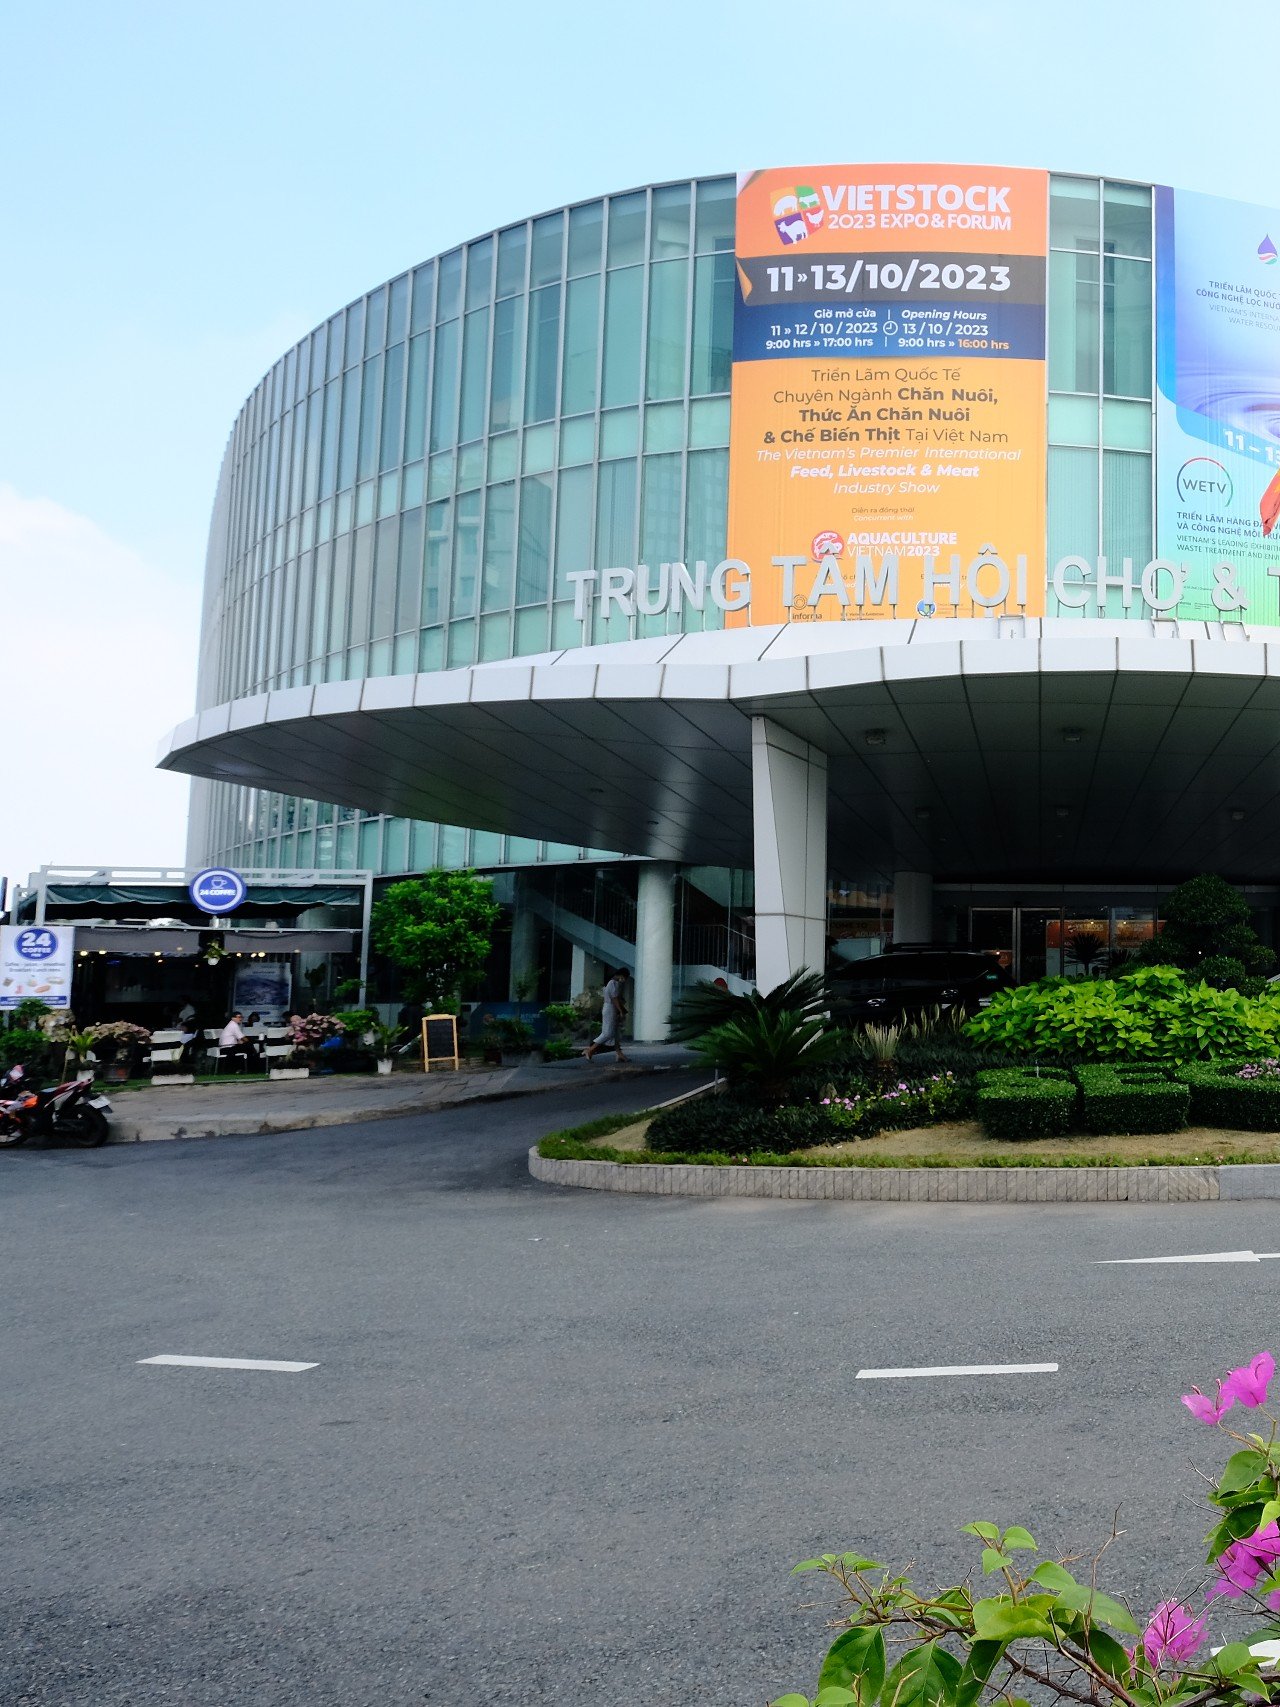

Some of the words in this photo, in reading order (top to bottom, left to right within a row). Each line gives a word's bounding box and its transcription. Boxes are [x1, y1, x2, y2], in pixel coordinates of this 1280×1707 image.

[821, 184, 1011, 213] VIETSTOCK
[828, 214, 876, 229] 2023
[814, 309, 833, 319] Giờ
[835, 308, 853, 318] mở
[856, 308, 877, 318] cửa
[901, 309, 951, 320] Opening
[953, 310, 988, 320] Hours
[771, 325, 781, 336] 11
[766, 340, 790, 349] 9:00
[793, 339, 811, 348] hrs
[823, 338, 852, 347] 17:00
[854, 338, 873, 347] hrs
[898, 338, 924, 348] 9:00
[927, 338, 946, 348] hrs
[958, 339, 988, 349] 16:00
[991, 340, 1010, 350] hrs
[812, 367, 850, 381] Triển
[856, 369, 890, 381] Lãm
[895, 367, 938, 382] Quốc
[942, 367, 961, 381] Tế
[773, 390, 833, 405] Chuyên
[839, 388, 892, 404] Ngành
[898, 387, 944, 400] Chăn
[951, 388, 998, 405] Nuôi,
[799, 407, 842, 422] Thức
[847, 405, 871, 421] Ăn
[877, 407, 923, 421] Chăn
[928, 407, 970, 421] Nuôi
[764, 431, 776, 444] &
[780, 427, 815, 443] Chế
[820, 427, 860, 442] Biến
[865, 427, 901, 444] Thịt
[906, 428, 928, 444] Tại
[932, 428, 965, 444] Việt
[970, 430, 1008, 443] Nam
[757, 450, 781, 461] The
[860, 446, 920, 459] Premier
[925, 446, 1022, 461] International
[790, 465, 834, 479] Feed,
[838, 464, 916, 477] Livestock
[920, 464, 932, 476] &
[936, 465, 980, 477] Meat
[833, 482, 896, 495] Industry
[898, 481, 940, 493] Show
[1183, 478, 1227, 494] WETV
[1205, 514, 1224, 523] LÃM
[1227, 517, 1251, 527] HÀNG
[1177, 521, 1189, 530] VÀ
[1191, 521, 1216, 533] CÔNG
[1218, 526, 1242, 537] NGHỆ
[847, 532, 957, 545] AQUACULTURE
[1177, 534, 1216, 545] VIETNAM'S
[1218, 538, 1248, 549] LEADING
[1177, 543, 1202, 552] WASTE
[1205, 547, 1246, 557] TREATMENT
[1248, 551, 1262, 559] AND
[566, 558, 752, 621] TRUNG
[771, 542, 898, 607] TÂM
[1211, 560, 1250, 612] &
[22, 932, 52, 947] 24
